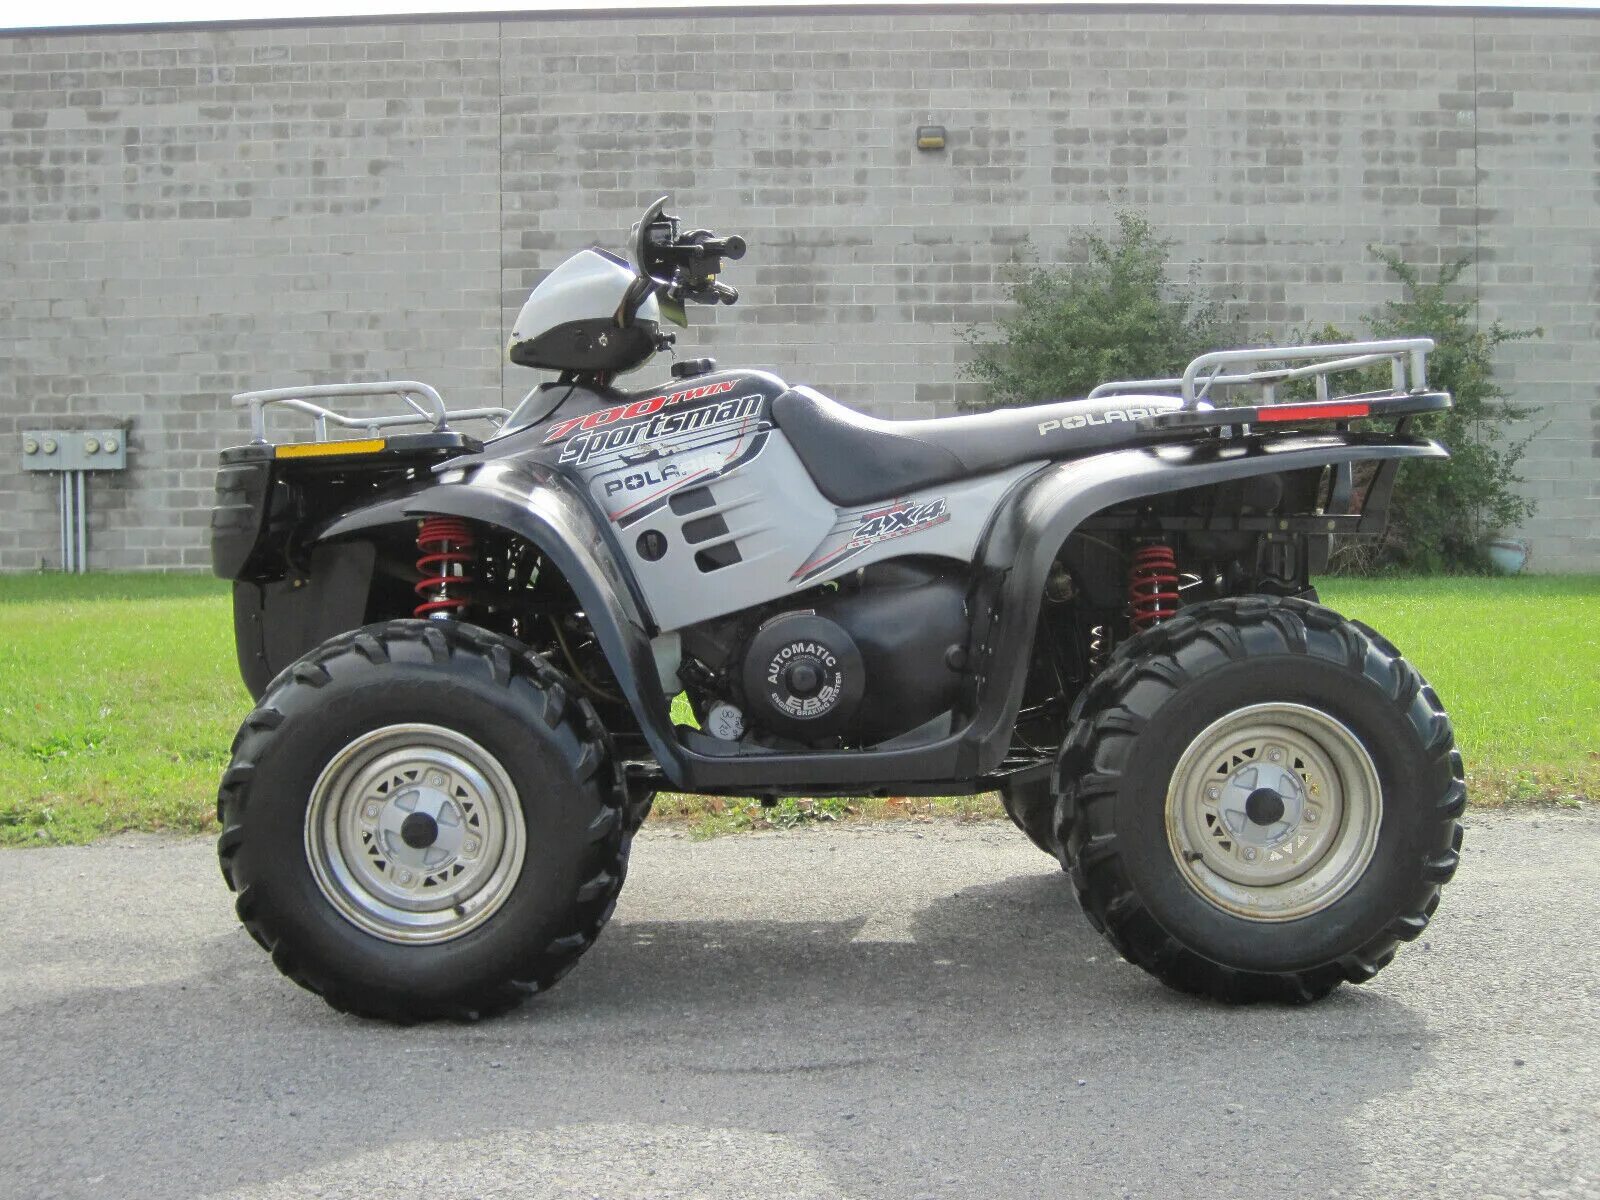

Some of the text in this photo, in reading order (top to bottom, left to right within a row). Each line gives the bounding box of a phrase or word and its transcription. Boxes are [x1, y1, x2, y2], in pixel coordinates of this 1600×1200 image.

[543, 379, 740, 443] 700 TWIN
[558, 395, 763, 466] Sportsman
[767, 642, 837, 684] AUTOMATIC
[771, 692, 796, 715] ENGINE
[796, 702, 830, 716] BRAKING
[829, 671, 842, 703] SYSTEM
[785, 685, 834, 711] EBS
